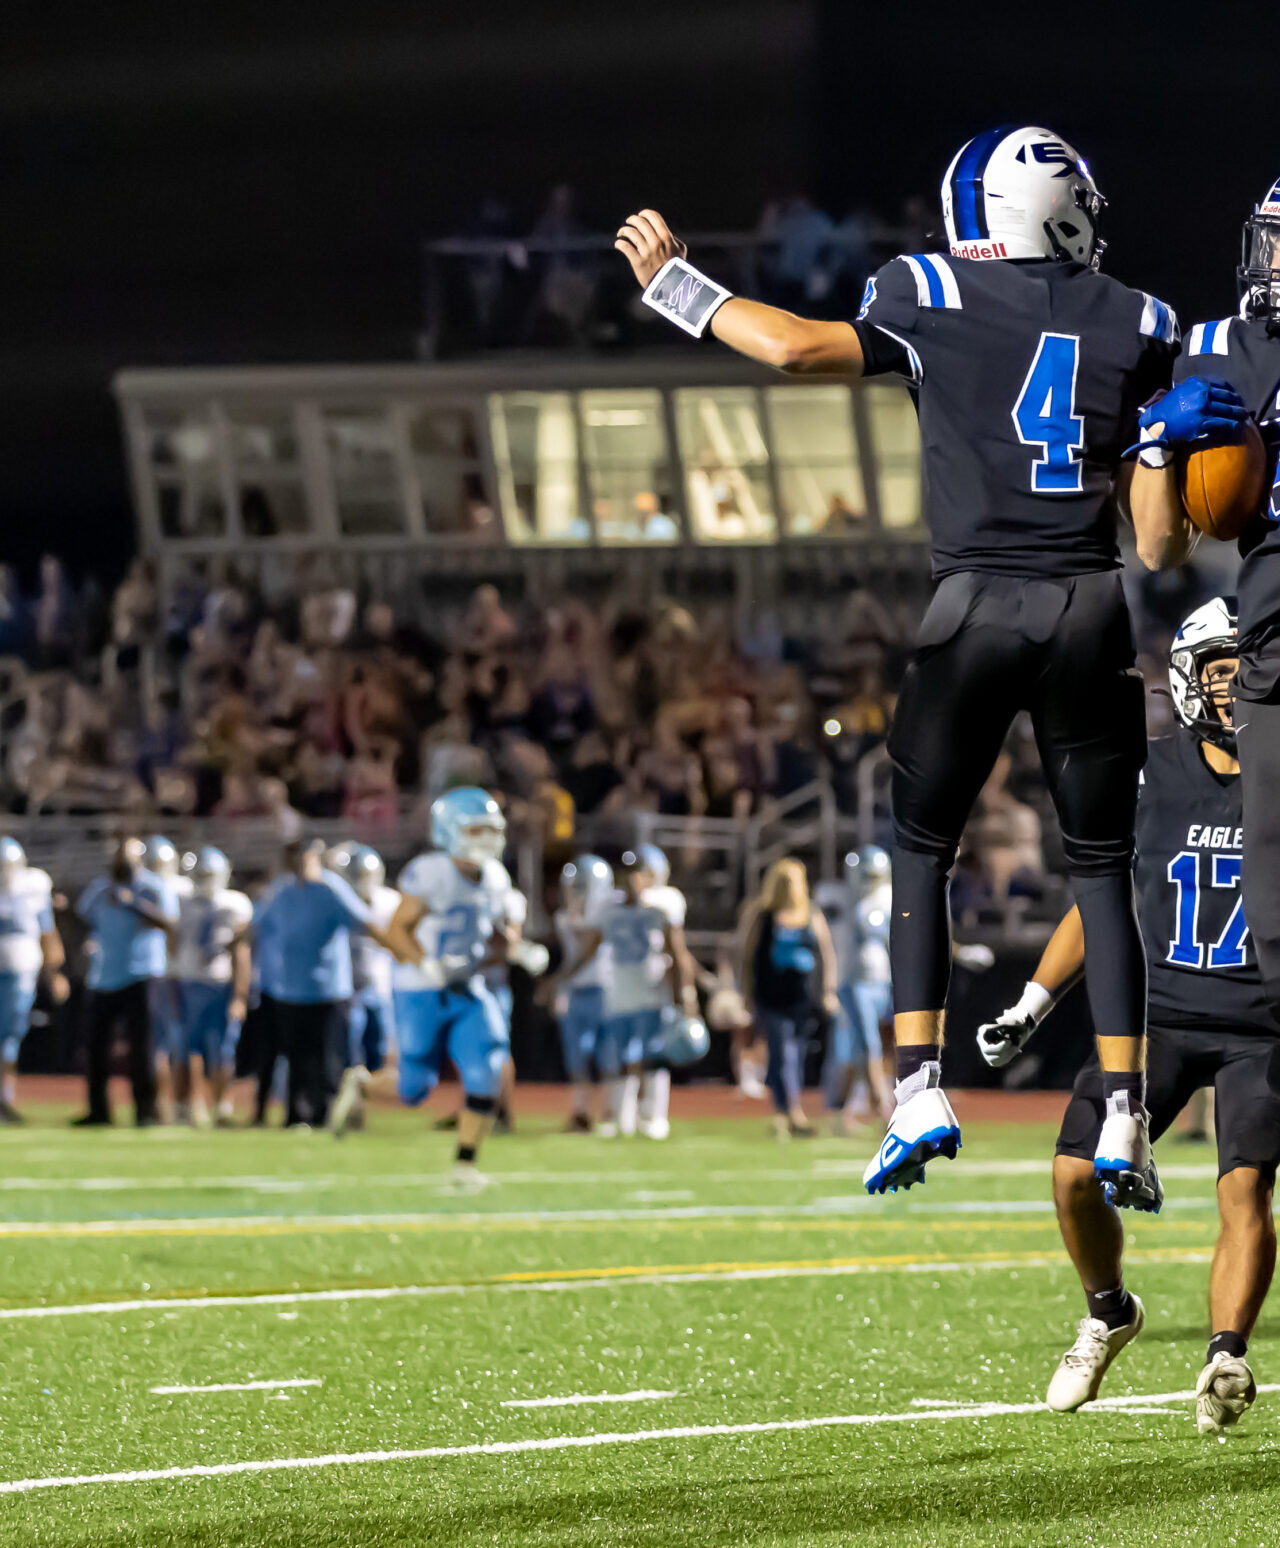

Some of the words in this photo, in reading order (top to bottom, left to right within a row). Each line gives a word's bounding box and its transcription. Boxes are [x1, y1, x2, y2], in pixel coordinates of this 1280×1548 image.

[951, 242, 1008, 260] Riddell
[667, 273, 704, 313] N
[1011, 331, 1085, 492] 4
[1186, 824, 1243, 849] EAGLE
[1165, 850, 1249, 969] 17
